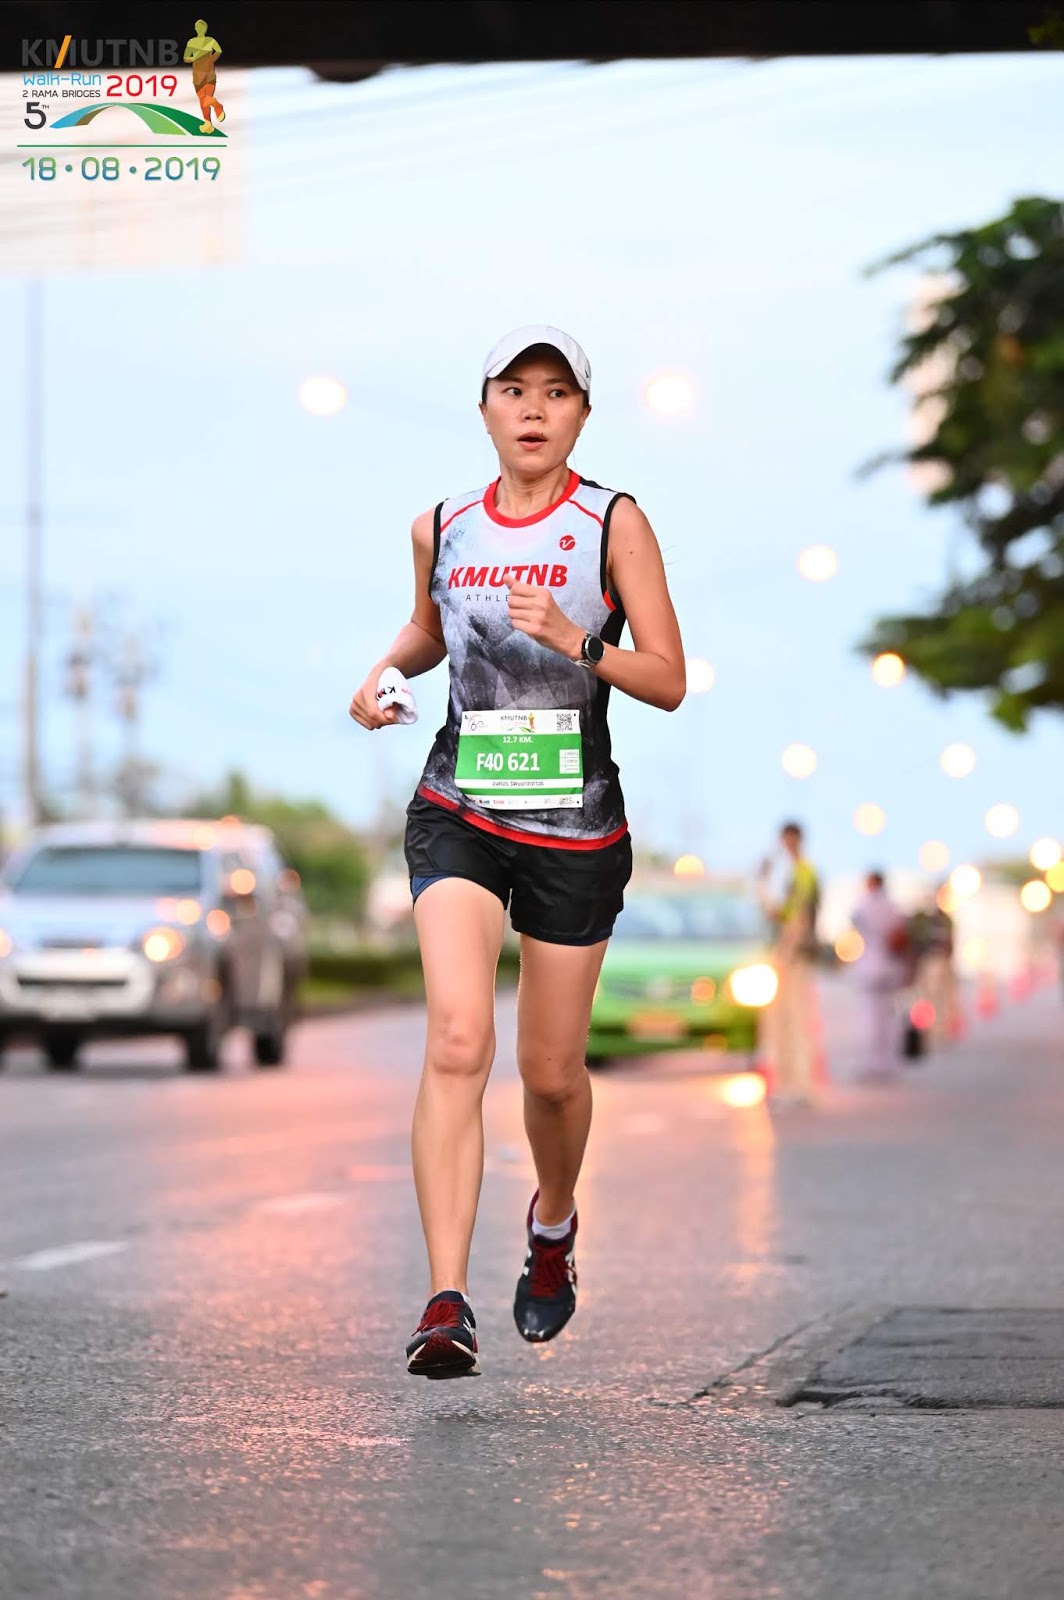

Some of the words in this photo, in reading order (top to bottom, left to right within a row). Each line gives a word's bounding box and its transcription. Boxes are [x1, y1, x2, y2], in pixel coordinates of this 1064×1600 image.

[448, 564, 568, 589] KMUTNB
[465, 594, 509, 602] ATHLE
[476, 752, 503, 771] F40
[507, 752, 540, 771] 621
